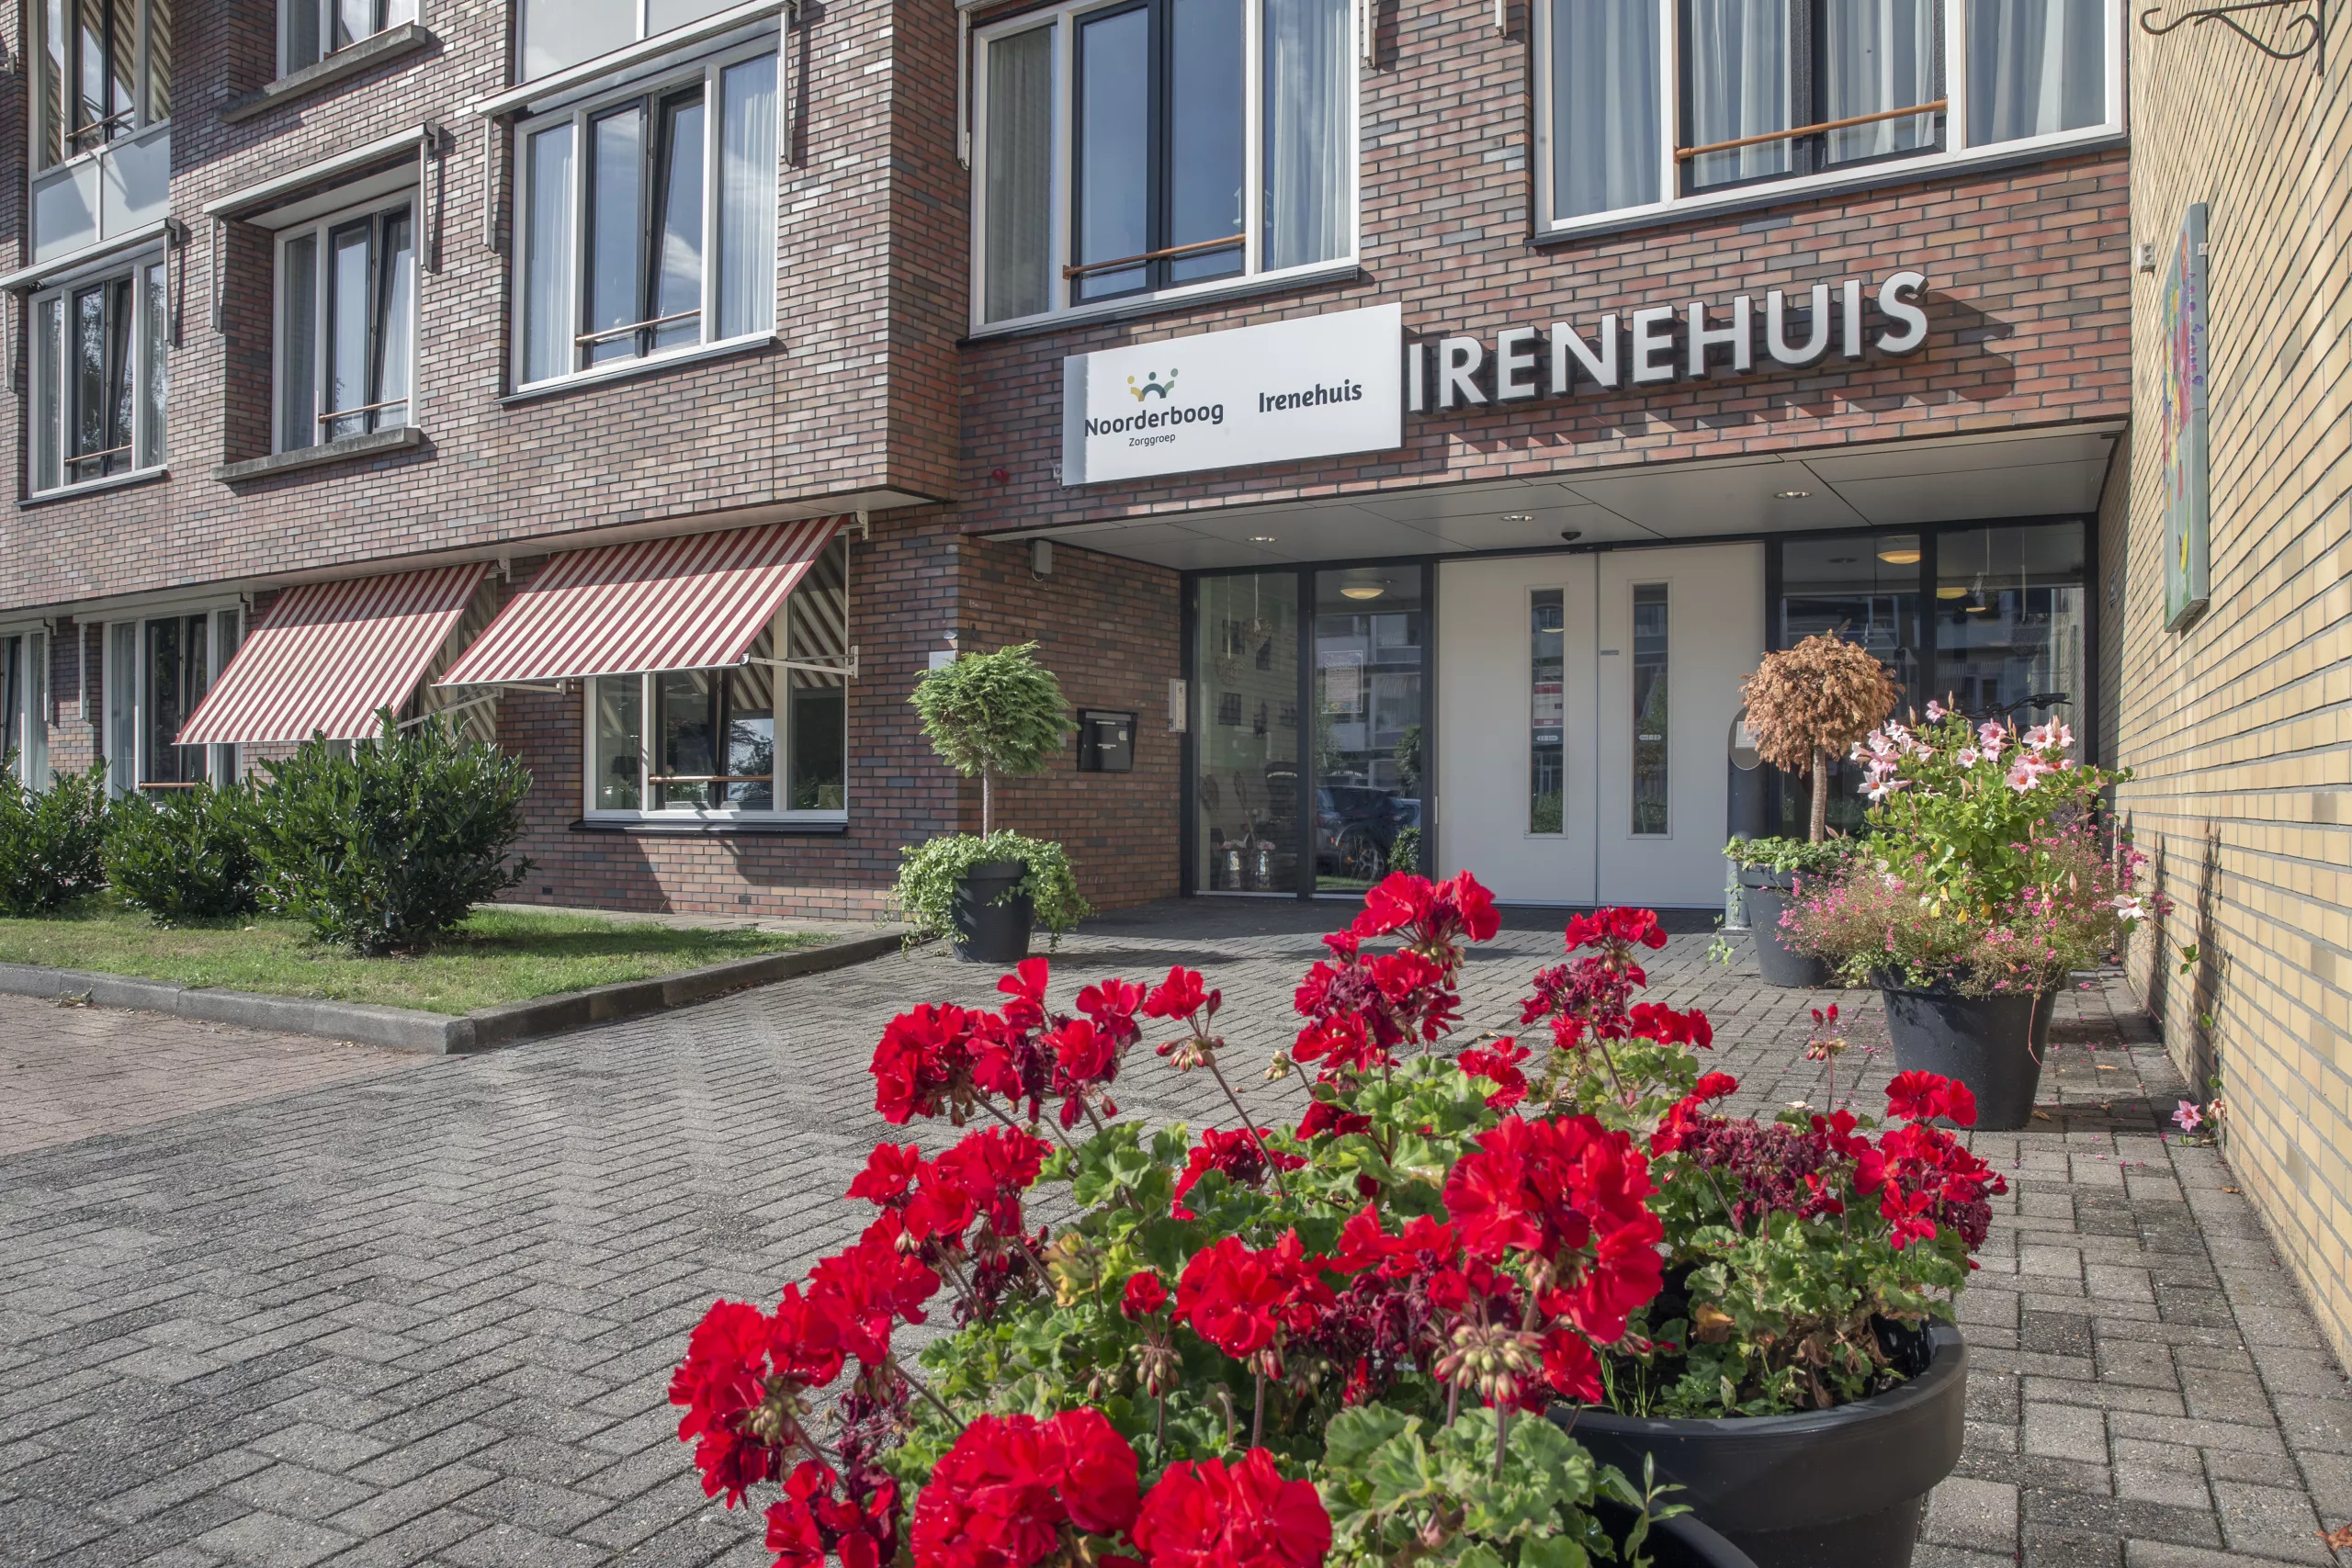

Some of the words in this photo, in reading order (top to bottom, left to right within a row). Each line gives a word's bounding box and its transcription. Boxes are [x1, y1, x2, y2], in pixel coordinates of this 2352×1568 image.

[1408, 271, 1928, 413] IRENEHUIS
[1259, 378, 1363, 413] Irenehuis
[1084, 403, 1224, 437] Noorderboog
[1128, 432, 1176, 447] Zorggroep
